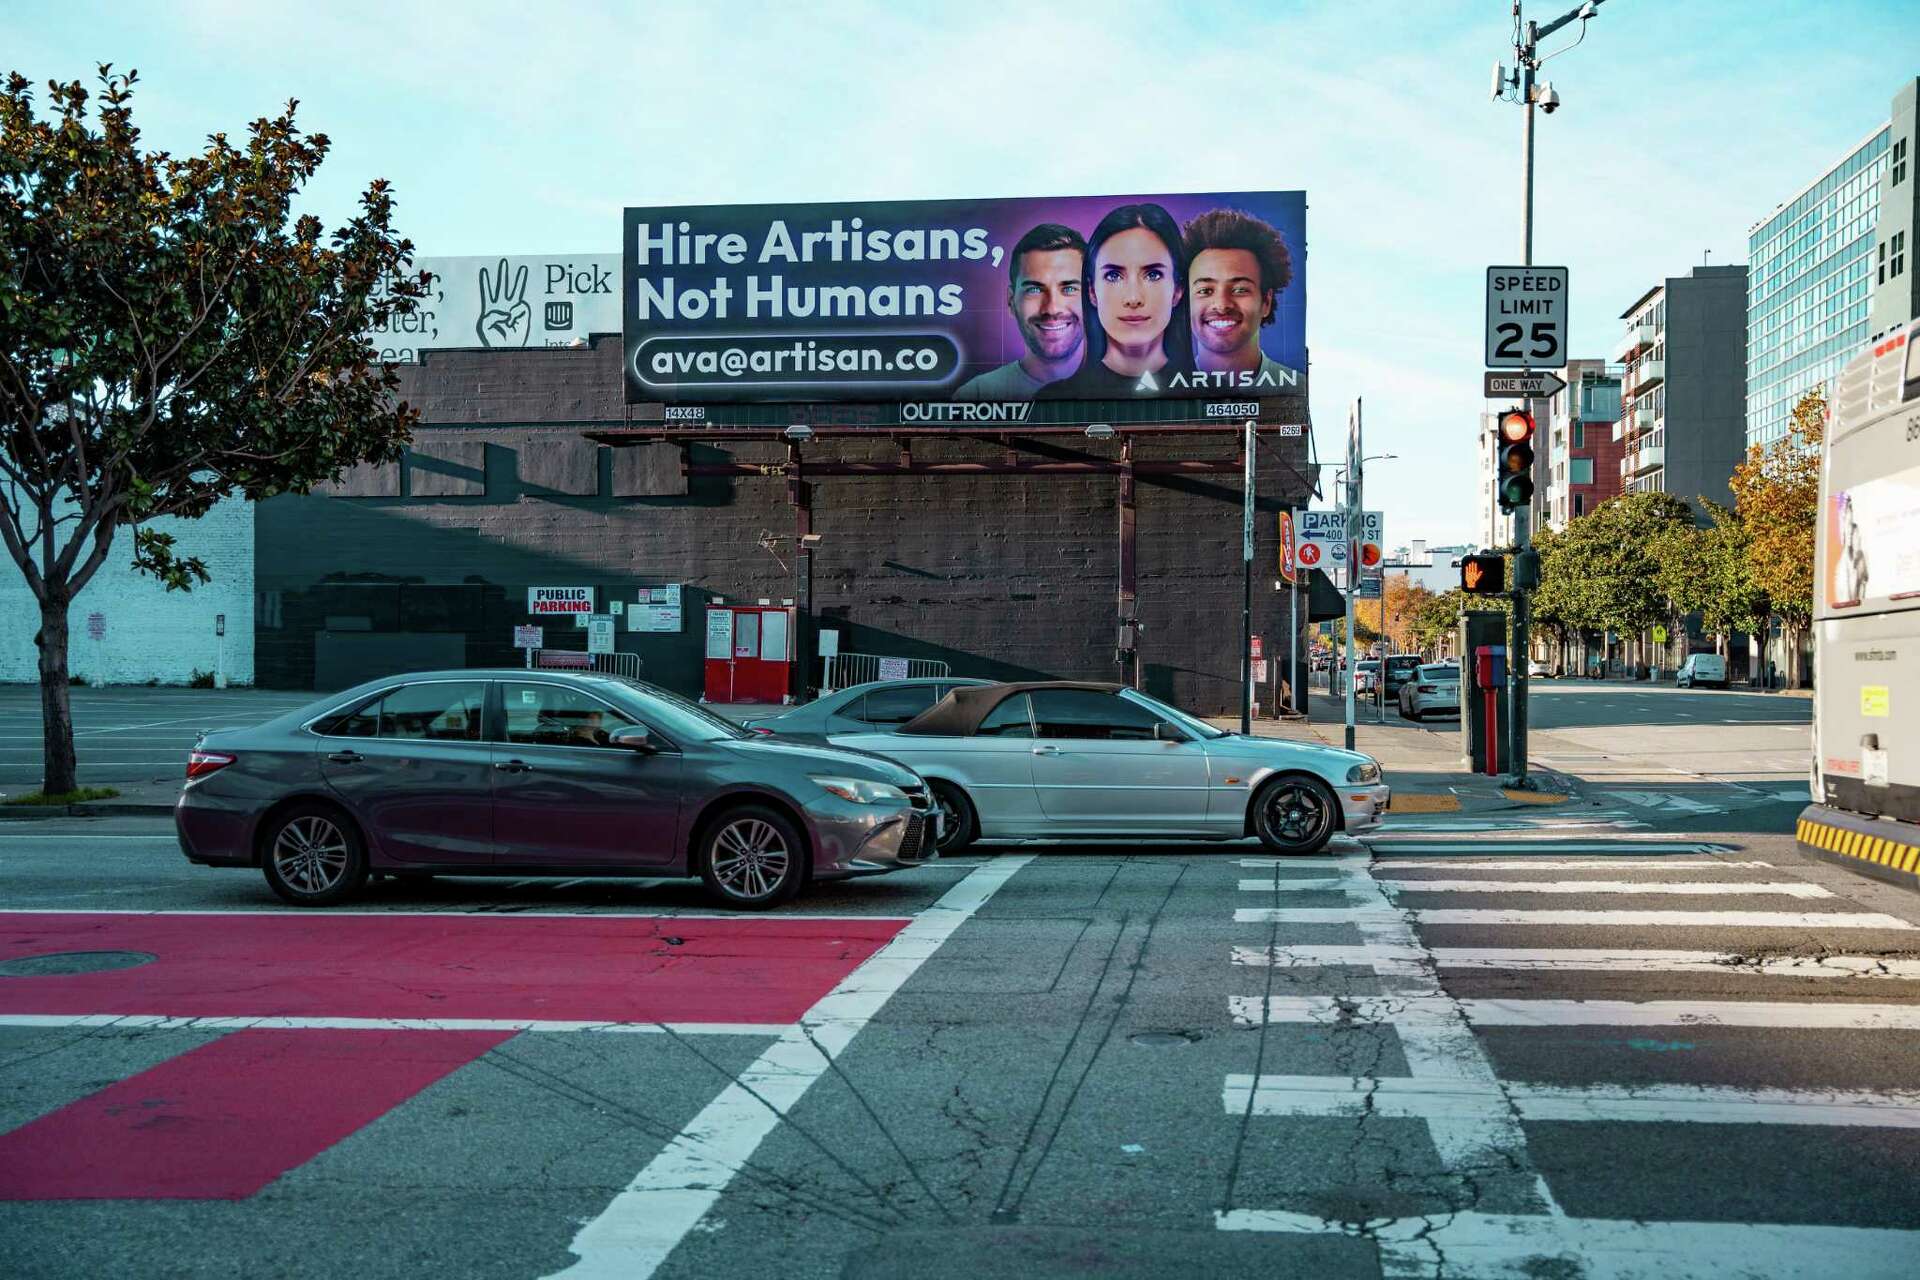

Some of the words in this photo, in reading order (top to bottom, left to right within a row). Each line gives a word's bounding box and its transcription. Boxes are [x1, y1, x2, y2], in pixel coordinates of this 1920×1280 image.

[638, 221, 748, 265] Hire
[758, 217, 1004, 267] Artisans,
[544, 264, 612, 294] Pick
[1494, 276, 1561, 291] SPEED
[638, 277, 733, 320] Not
[746, 275, 964, 317] Humans
[1501, 299, 1554, 314] LIMIT
[1494, 322, 1558, 358] 25
[651, 341, 939, 376] ava@artisan.co
[1168, 370, 1297, 388] ARTISAN
[1492, 379, 1516, 390] ONE
[1519, 379, 1542, 390] WAY
[1208, 404, 1258, 416] 464050
[1303, 513, 1376, 528] PARKG
[1325, 530, 1343, 540] 400
[1367, 530, 1380, 540] ST
[536, 589, 586, 600] PUBLIC
[532, 600, 591, 612] PARKING
